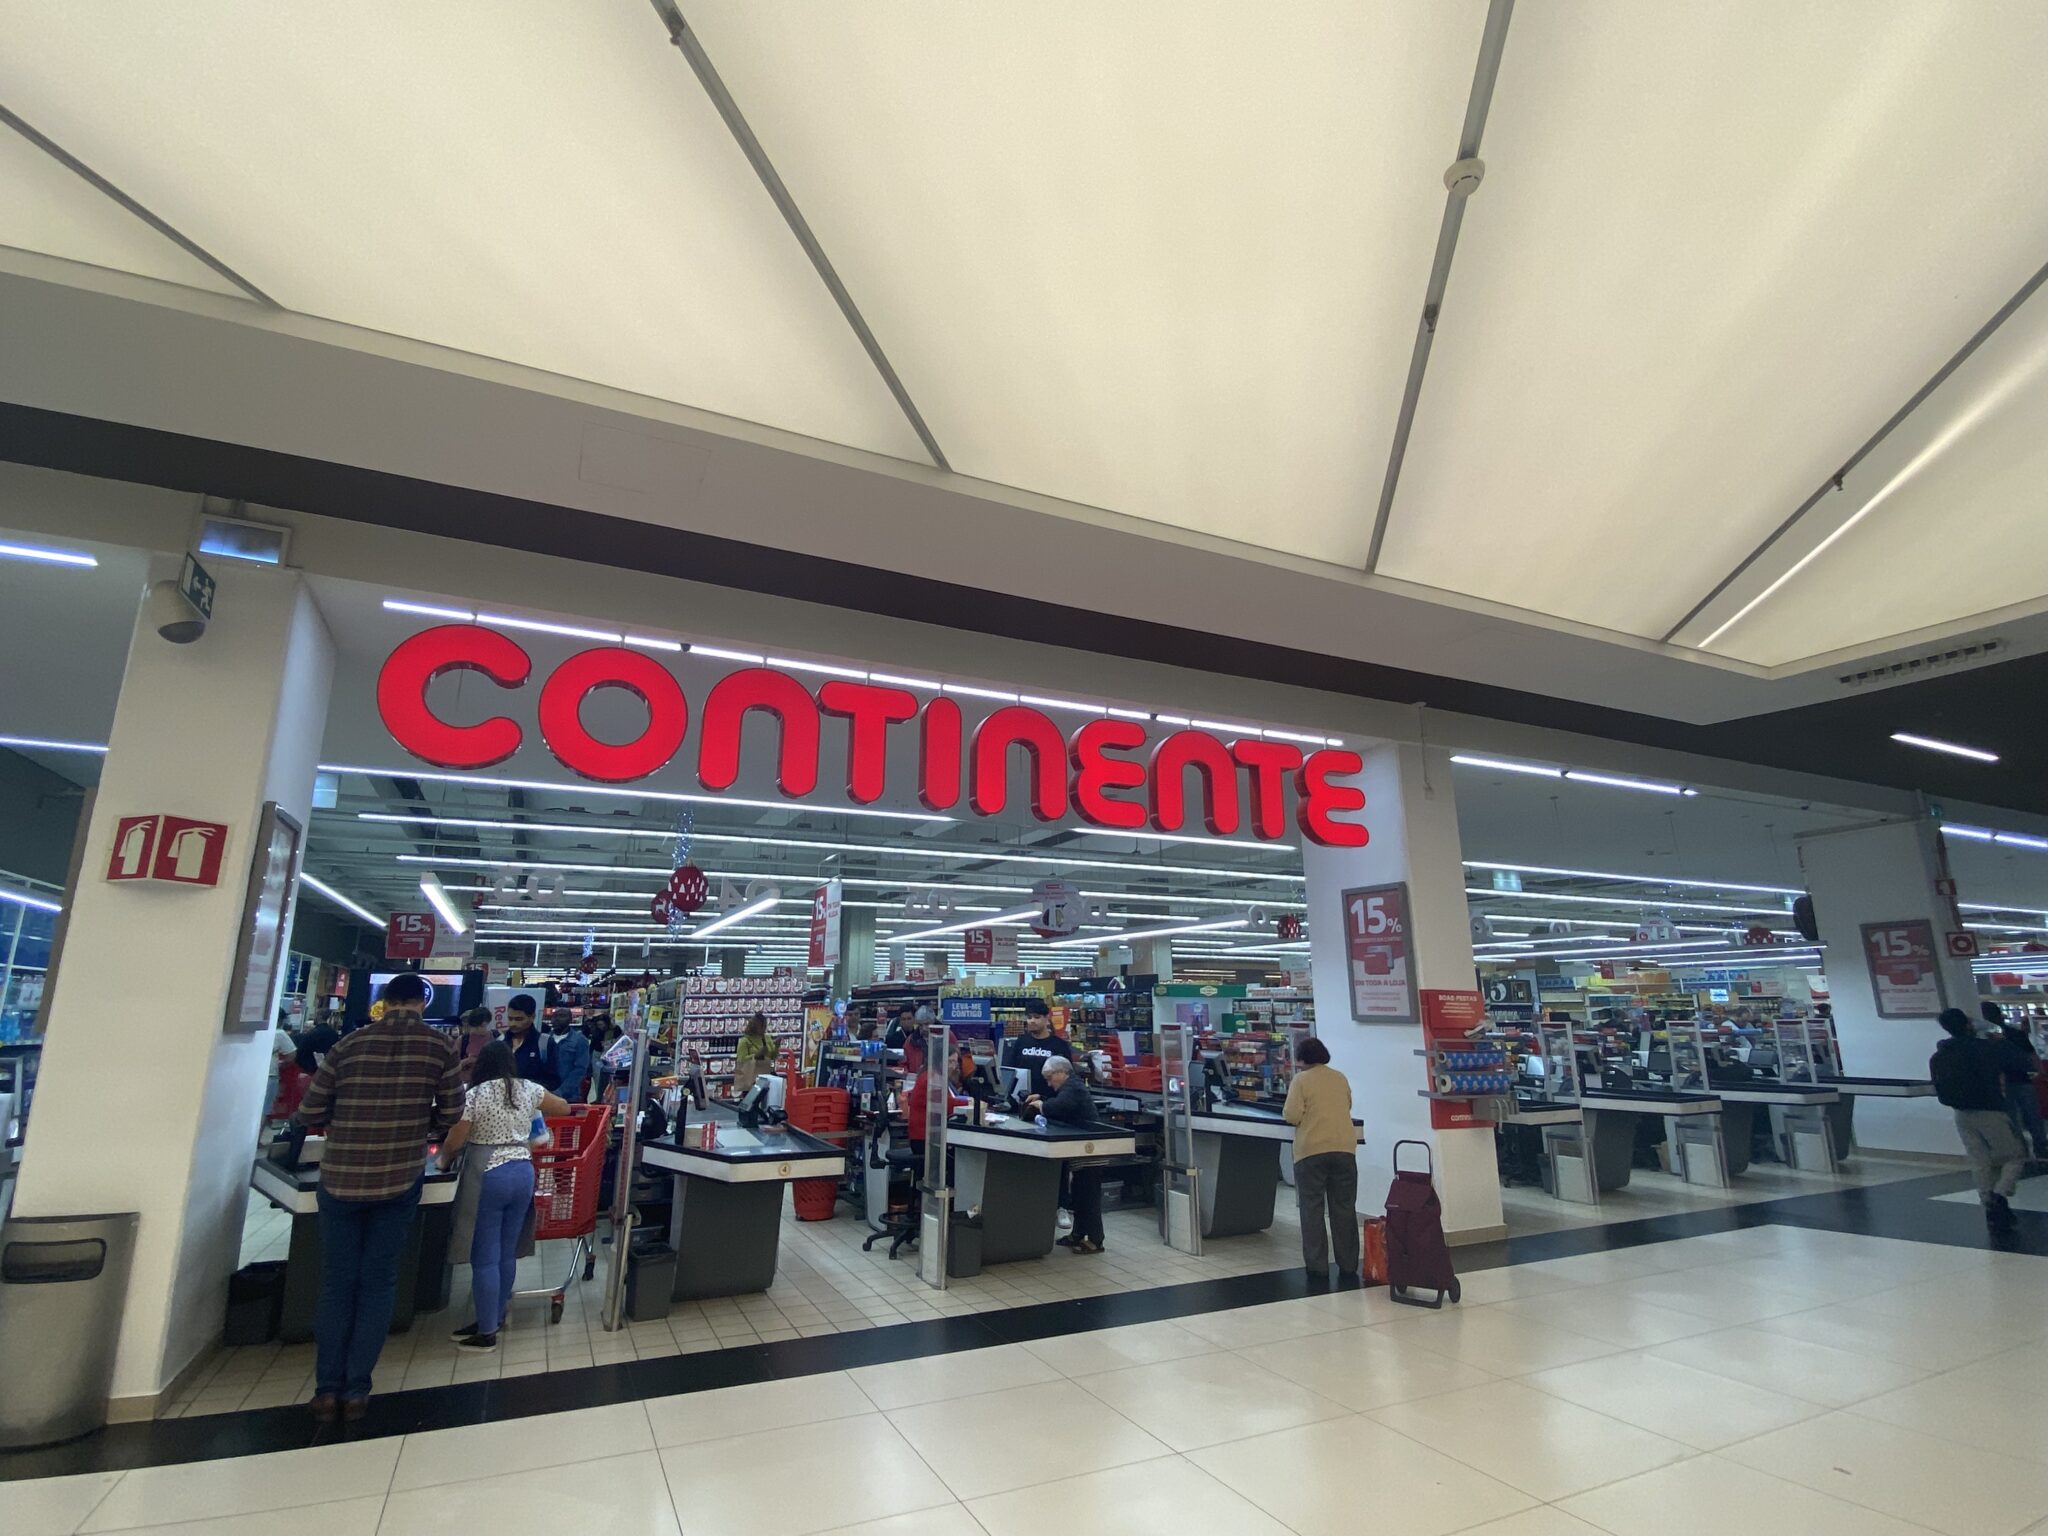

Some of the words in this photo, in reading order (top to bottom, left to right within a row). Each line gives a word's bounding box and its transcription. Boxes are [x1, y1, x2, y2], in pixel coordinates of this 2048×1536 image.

[376, 624, 1370, 848] CONTINENTE
[396, 914, 431, 932] 15%
[1350, 897, 1402, 934] 15%
[968, 929, 991, 944] 15%
[1870, 930, 1930, 957] 15%
[1022, 1047, 1052, 1057] adidas
